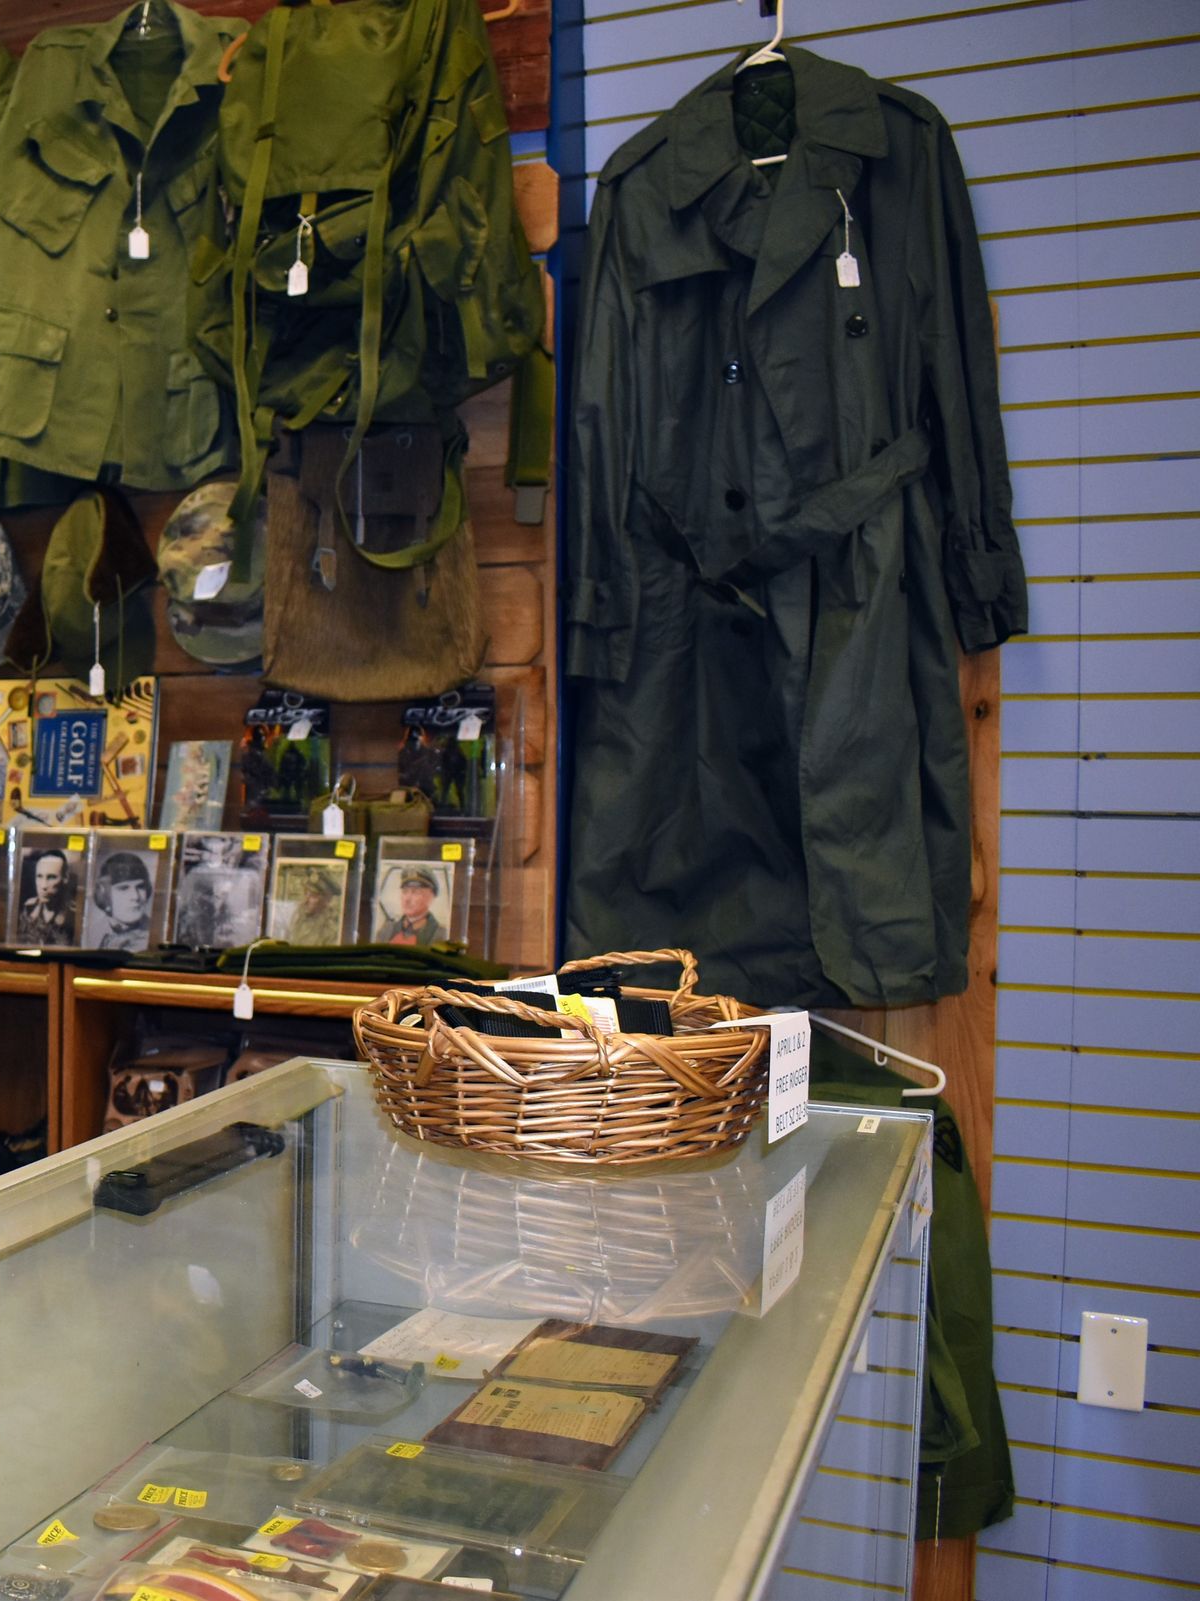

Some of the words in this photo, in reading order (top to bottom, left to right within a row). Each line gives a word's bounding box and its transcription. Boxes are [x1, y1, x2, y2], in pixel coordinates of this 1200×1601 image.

[67, 720, 88, 788] GOLF
[776, 1037, 792, 1059] APRIL
[797, 1032, 801, 1050] &
[802, 1031, 806, 1048] 2
[776, 1074, 789, 1096] FREE
[789, 1065, 808, 1089] RIGGER
[776, 1112, 788, 1134] BELT
[789, 1107, 795, 1126] SZ
[142, 1487, 157, 1501] PRICE
[178, 1491, 189, 1505] PRICE
[263, 1520, 285, 1533] PRICE
